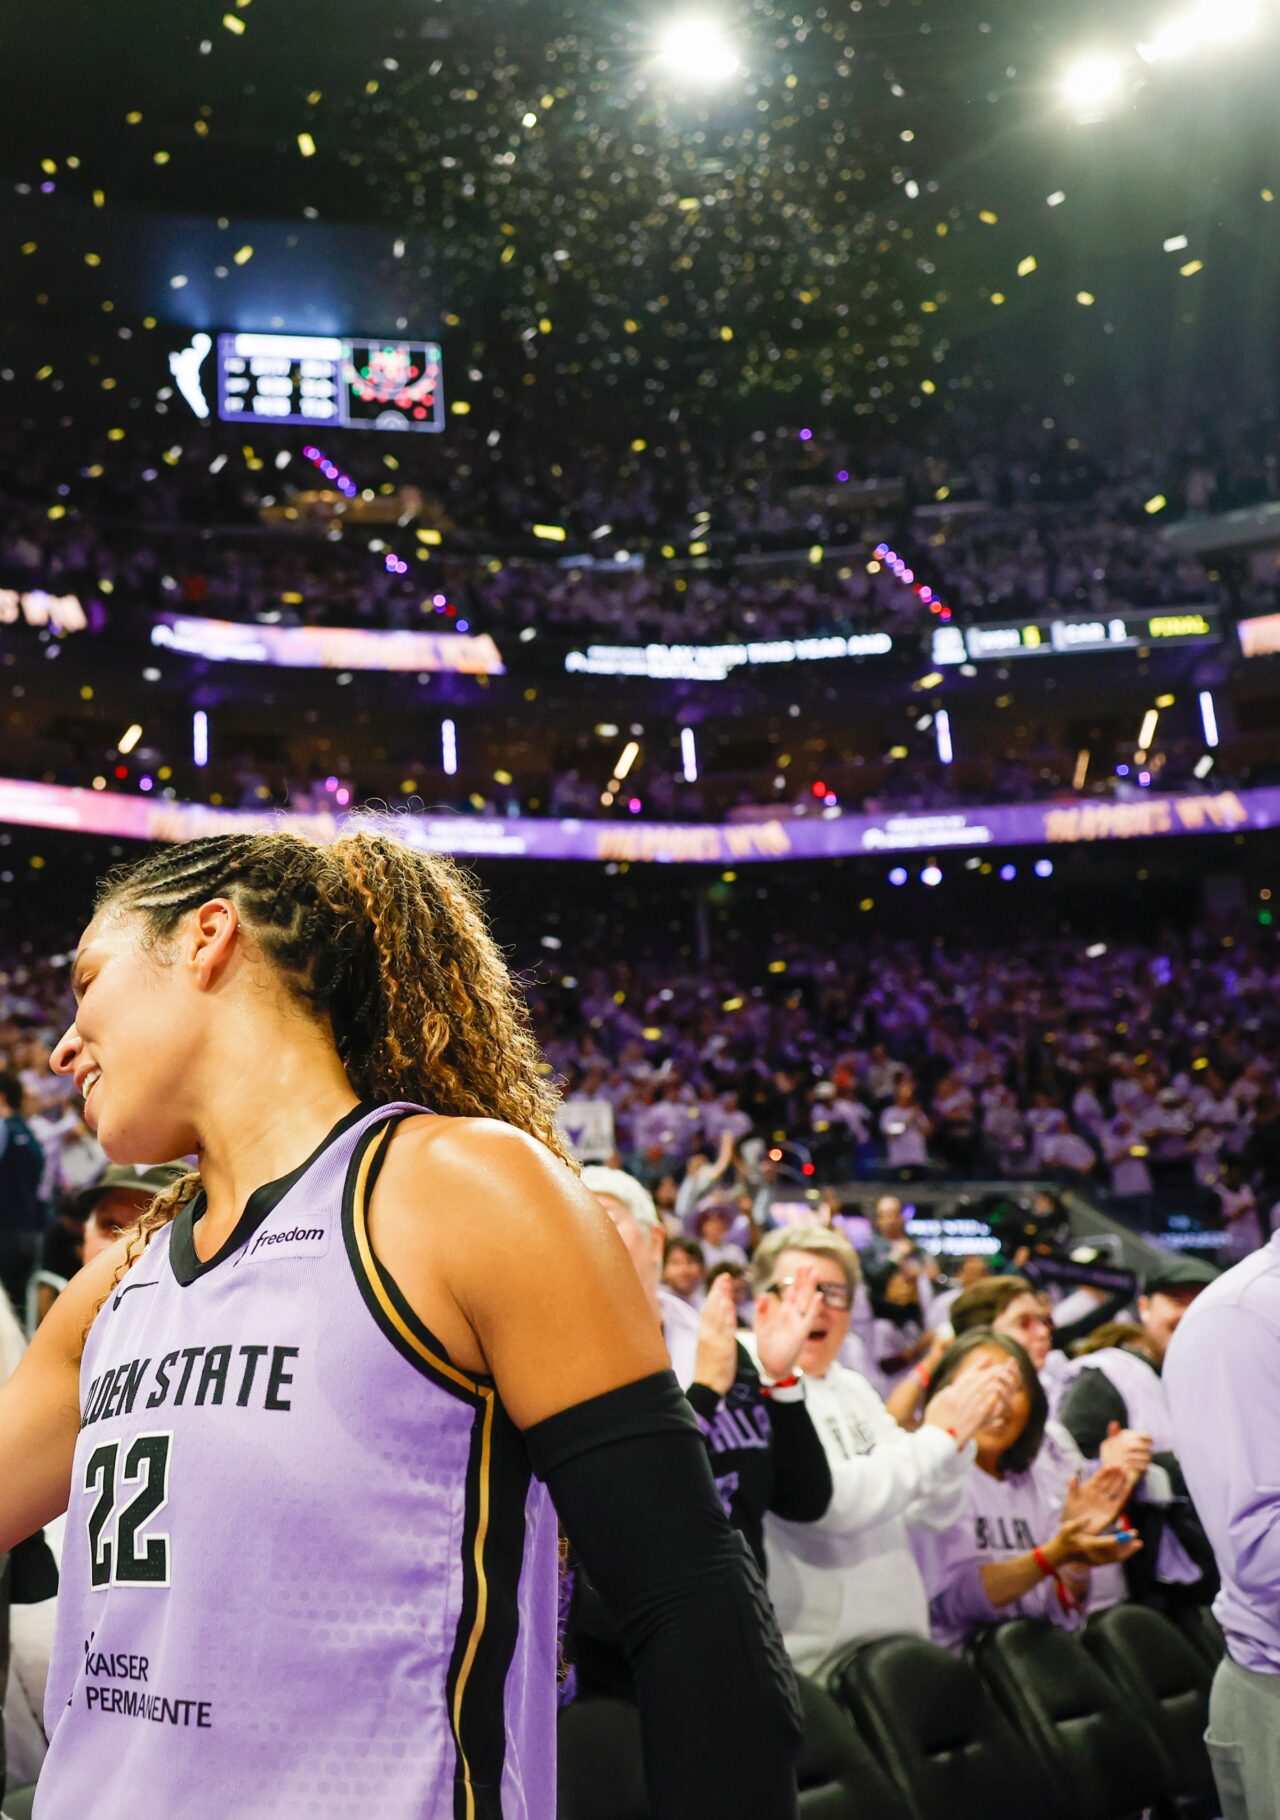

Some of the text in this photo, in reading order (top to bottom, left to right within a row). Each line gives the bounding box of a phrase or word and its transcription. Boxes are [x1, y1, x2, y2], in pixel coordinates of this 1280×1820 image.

[250, 1226, 324, 1255] freedom
[145, 1344, 300, 1411] STATE
[83, 1430, 174, 1592] 22
[85, 1652, 149, 1681] KAISER
[86, 1686, 213, 1728] PERMANENTE
